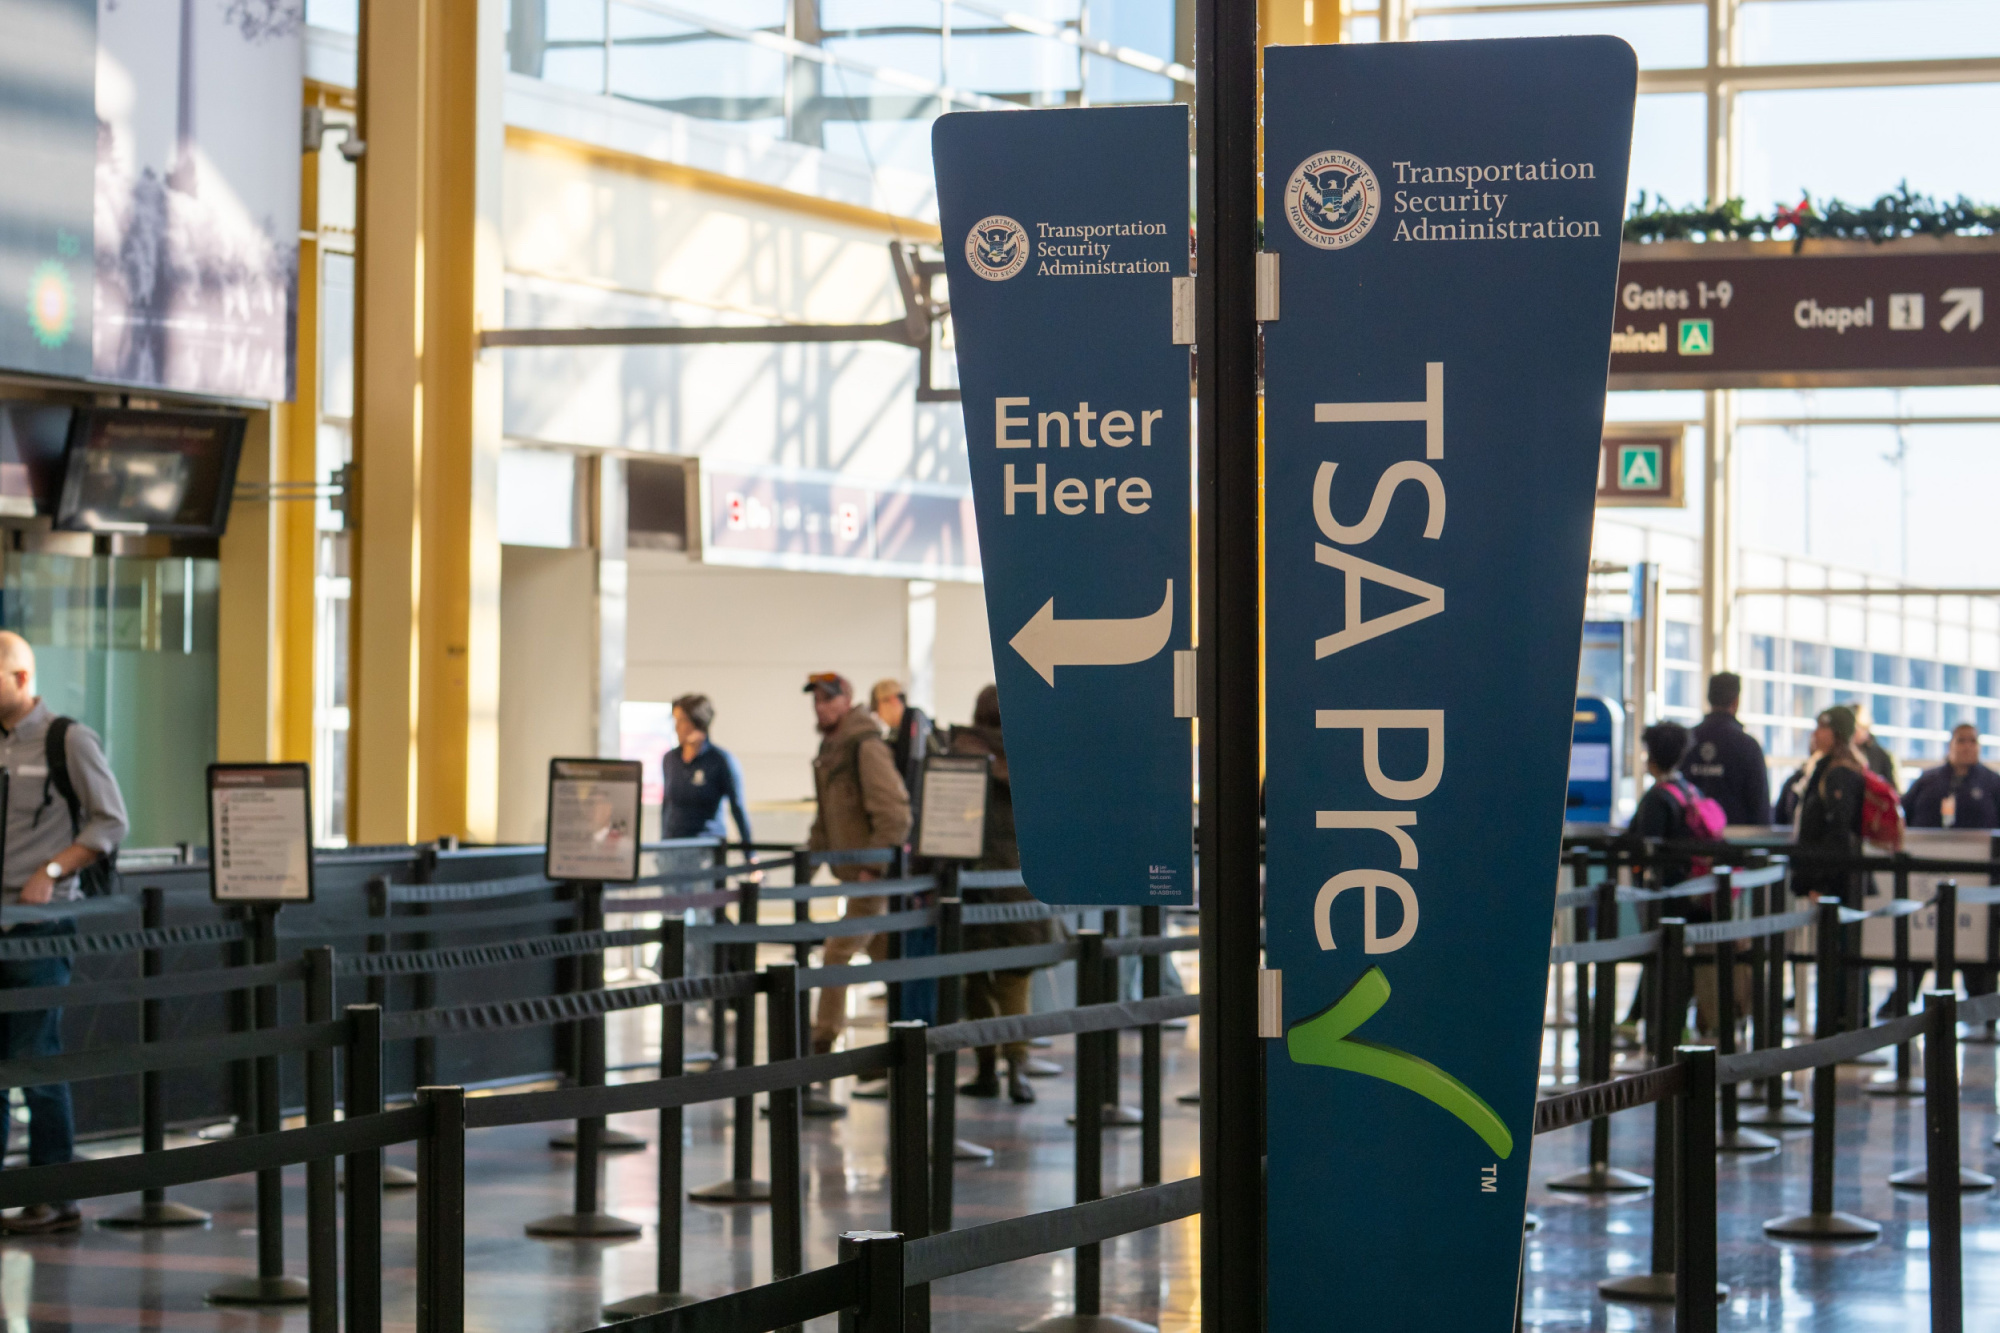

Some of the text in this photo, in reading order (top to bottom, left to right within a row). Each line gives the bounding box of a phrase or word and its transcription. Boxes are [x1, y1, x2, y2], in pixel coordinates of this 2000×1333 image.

[1305, 155, 1369, 179] DEPARTMENT
[1365, 178, 1375, 193] OF
[1393, 158, 1597, 190] Transportation
[1393, 190, 1508, 218] Security
[1036, 220, 1168, 242] Transportation
[1290, 203, 1375, 245] HOMELAND SECURITY
[1393, 216, 1601, 242] Administration
[969, 250, 1026, 278] HOMELAND SECURITY
[1036, 258, 1171, 276] Administration
[1037, 241, 1111, 261] Security
[1622, 279, 1734, 311] Gates 1-9
[1793, 297, 1874, 334] Chapel
[1610, 321, 1710, 354] minal A
[995, 396, 1163, 449] Enter
[1624, 450, 1656, 485] A
[1003, 462, 1153, 516] Here
[1312, 361, 1497, 1193] TSA Pre TM
